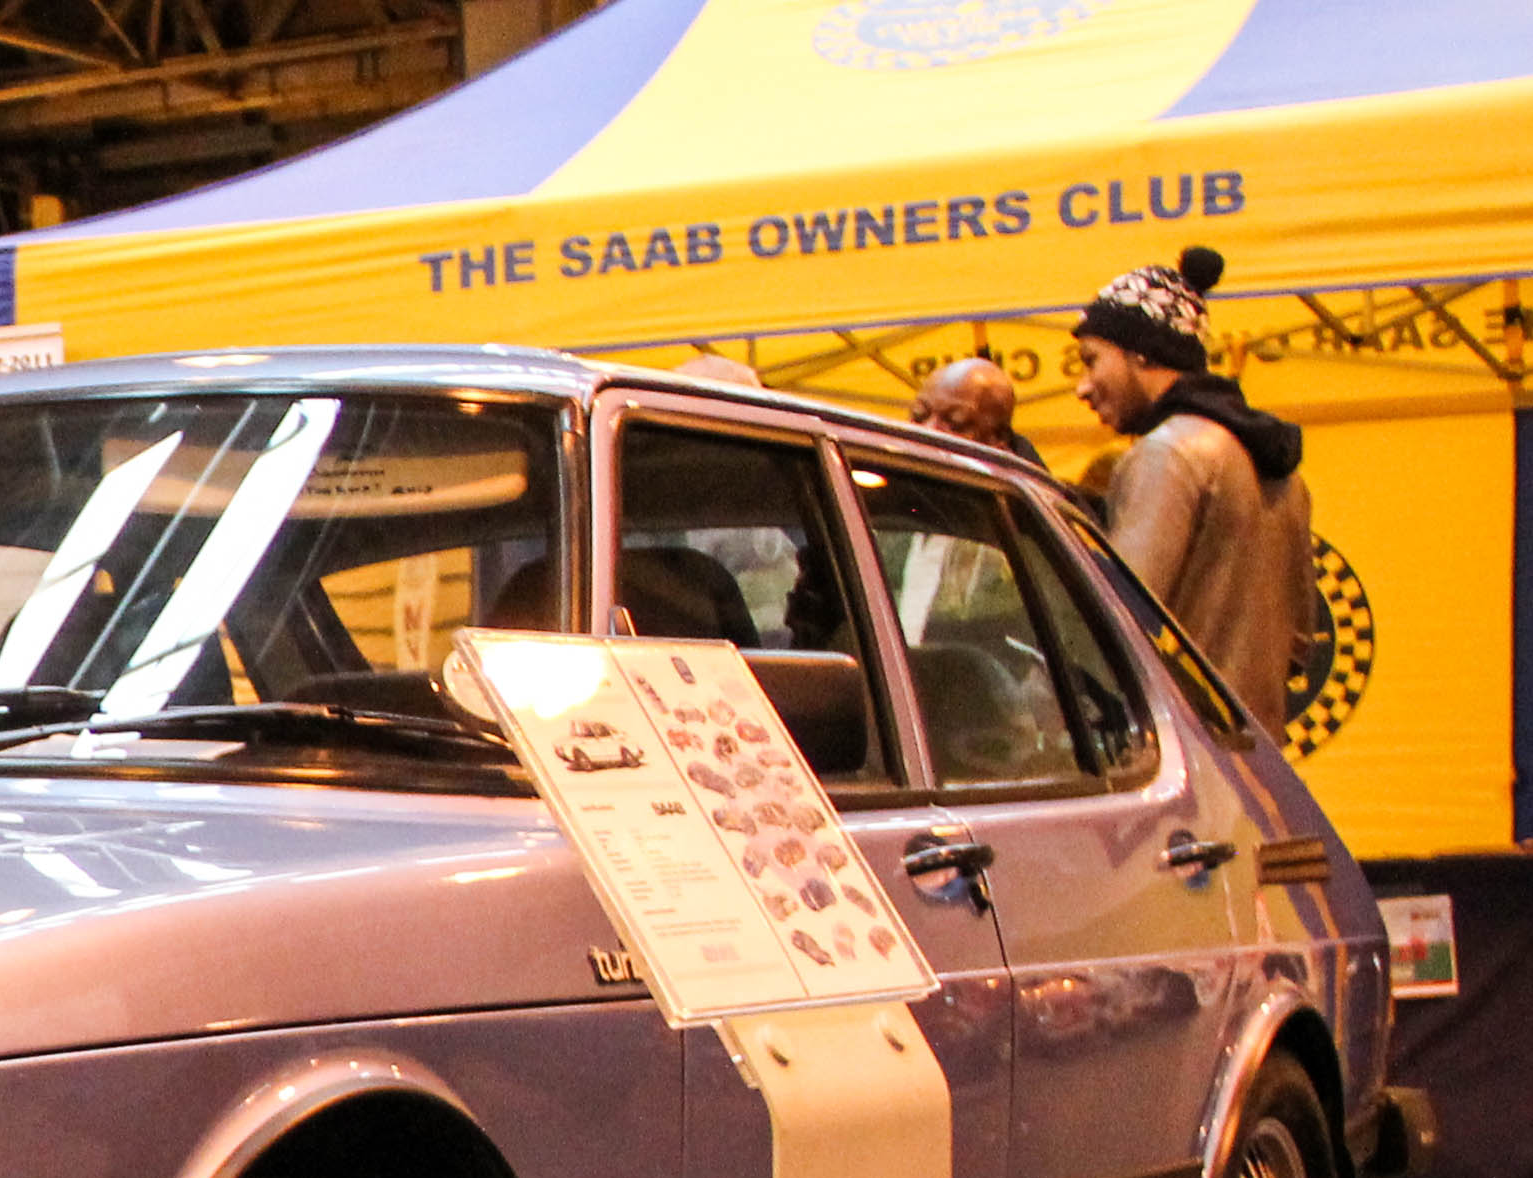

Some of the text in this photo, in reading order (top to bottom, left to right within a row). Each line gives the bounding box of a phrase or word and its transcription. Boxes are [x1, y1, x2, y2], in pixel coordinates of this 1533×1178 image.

[419, 171, 1247, 291] THE SAAB OWNERS CLUB
[590, 944, 638, 982] tur
